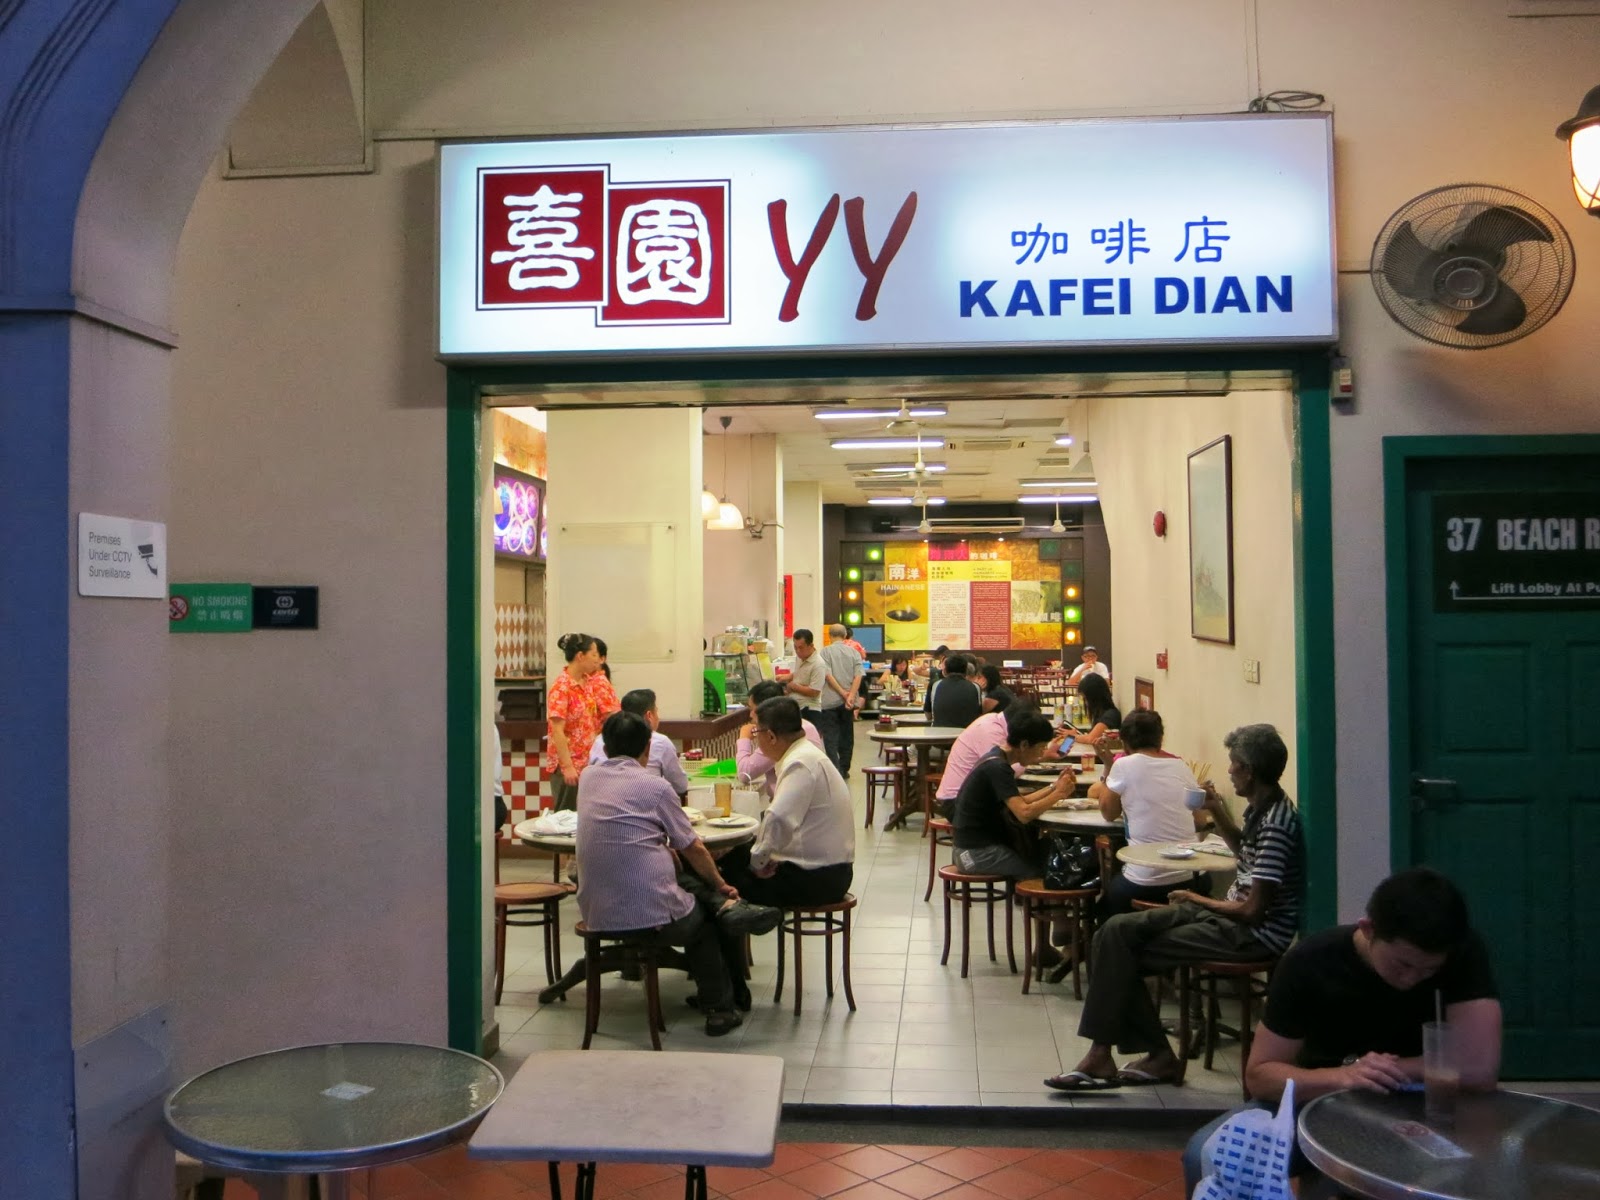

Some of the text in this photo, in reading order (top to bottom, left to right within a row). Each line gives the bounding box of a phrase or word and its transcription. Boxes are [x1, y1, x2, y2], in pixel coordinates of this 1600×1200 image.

[1010, 216, 1231, 265] 咖啡店
[959, 275, 1293, 318] KAFEI DIAN
[88, 531, 122, 546] Premises
[1446, 517, 1482, 552] 37
[1497, 517, 1577, 551] BEACH
[88, 548, 133, 563] Under CCTV
[88, 564, 132, 579] Surveillance
[888, 563, 920, 580] 南洋
[1491, 583, 1515, 594] Lift
[1519, 582, 1562, 596] Lobby
[1566, 582, 1581, 593] At
[192, 595, 248, 607] NO SMOKING
